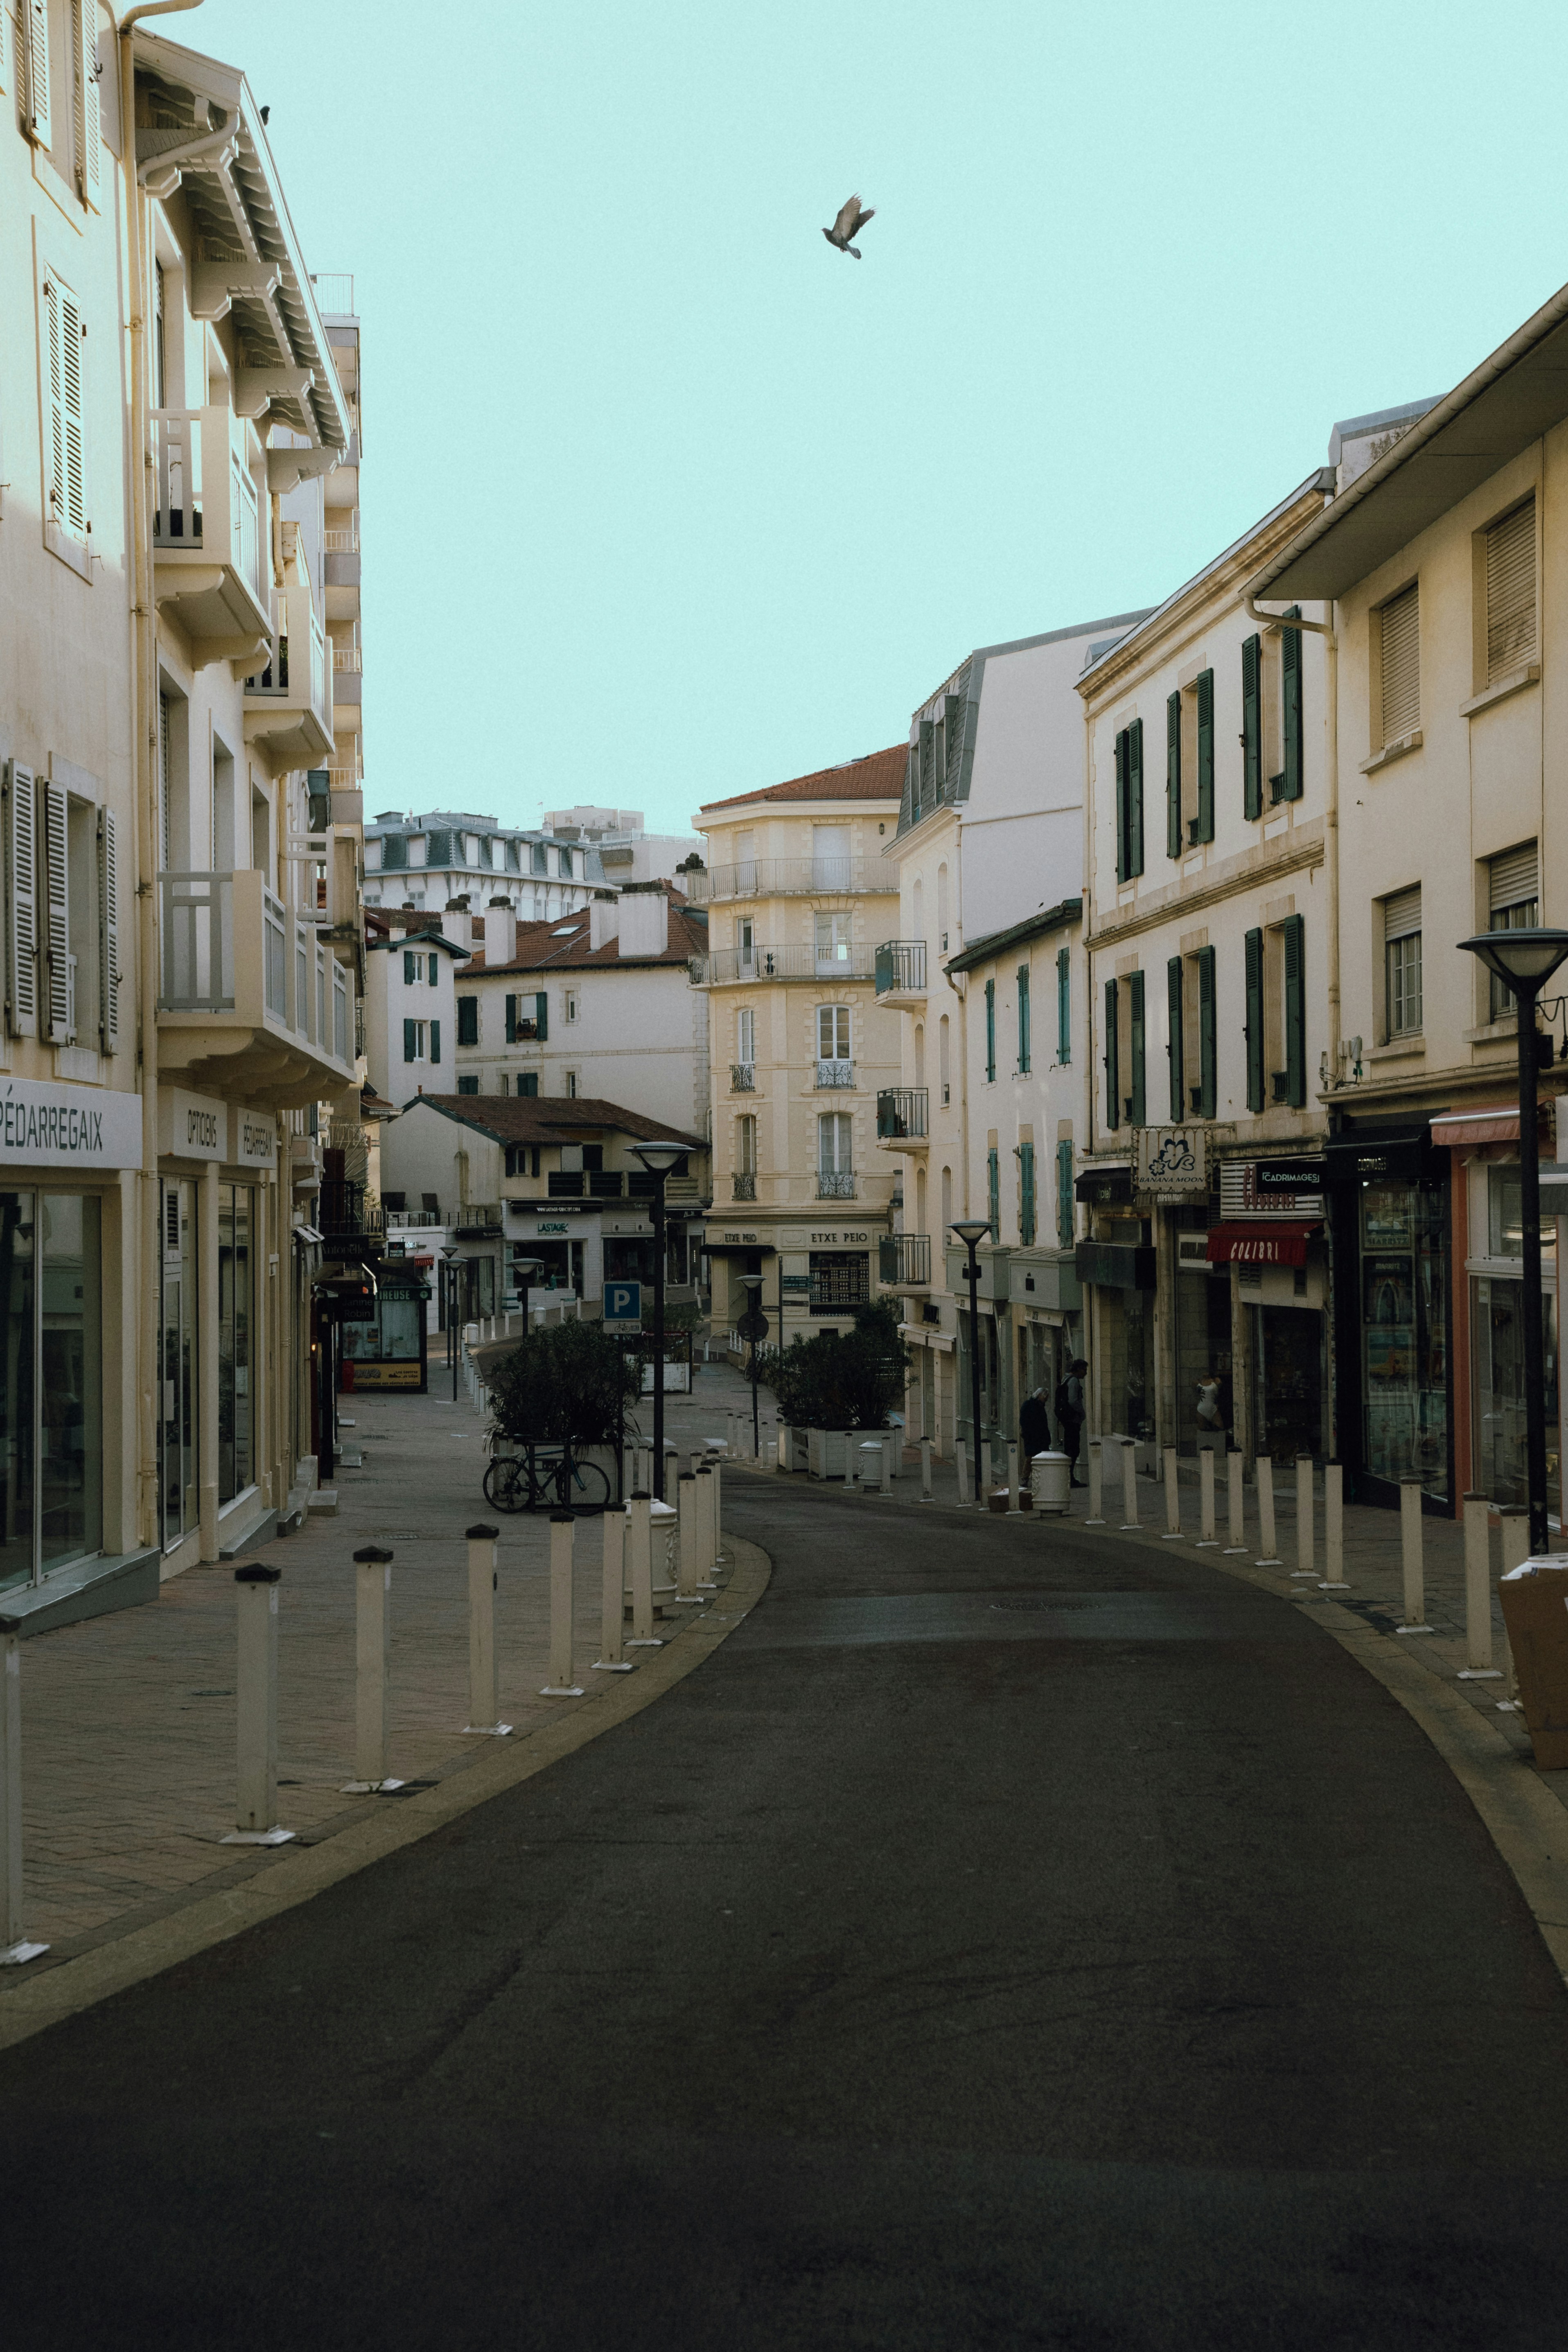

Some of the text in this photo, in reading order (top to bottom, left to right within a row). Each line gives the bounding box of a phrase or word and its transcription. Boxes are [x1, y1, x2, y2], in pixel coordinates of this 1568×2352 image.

[188, 1109, 217, 1148] OPTICIENS
[244, 1113, 272, 1158] PÉDARREGAIX
[1264, 1174, 1318, 1182] CADRIMAGES
[537, 1223, 566, 1232] LASTAGE
[724, 1233, 756, 1242] ETXE PEIO
[812, 1233, 867, 1242] ETXE PEIO
[1230, 1241, 1278, 1261] COLIBRI
[614, 1289, 630, 1313] P
